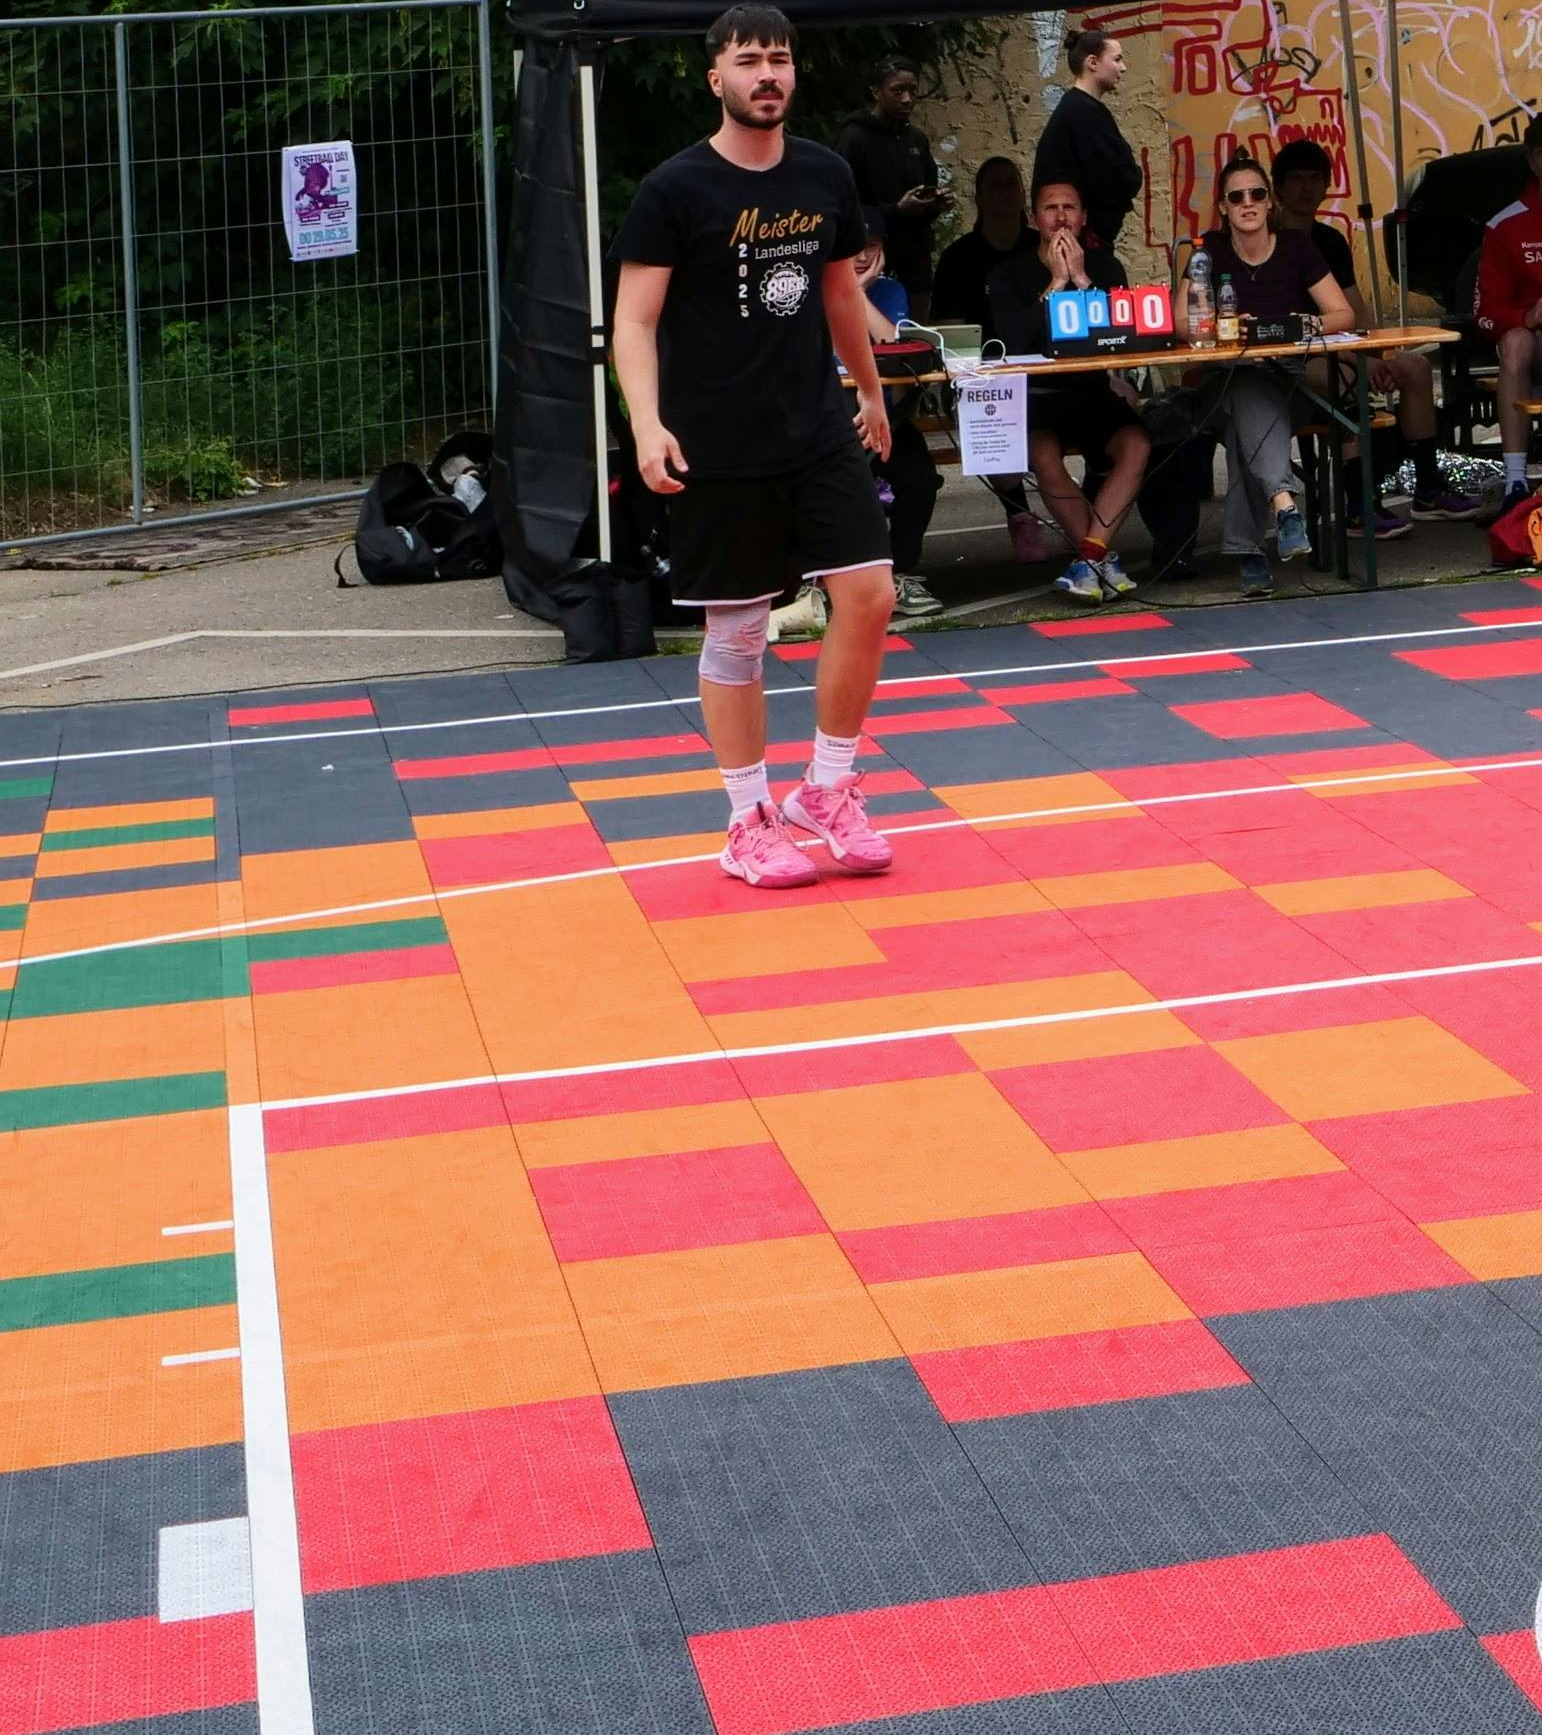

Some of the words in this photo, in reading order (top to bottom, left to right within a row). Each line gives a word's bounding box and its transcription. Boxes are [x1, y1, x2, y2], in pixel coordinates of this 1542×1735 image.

[729, 207, 823, 247] Meister
[755, 240, 820, 259] Landesliga
[1058, 300, 1080, 334] 0
[1088, 301, 1103, 324] 0
[1114, 298, 1131, 323] 0
[1142, 294, 1164, 329] 0
[967, 388, 1013, 403] REGELN
